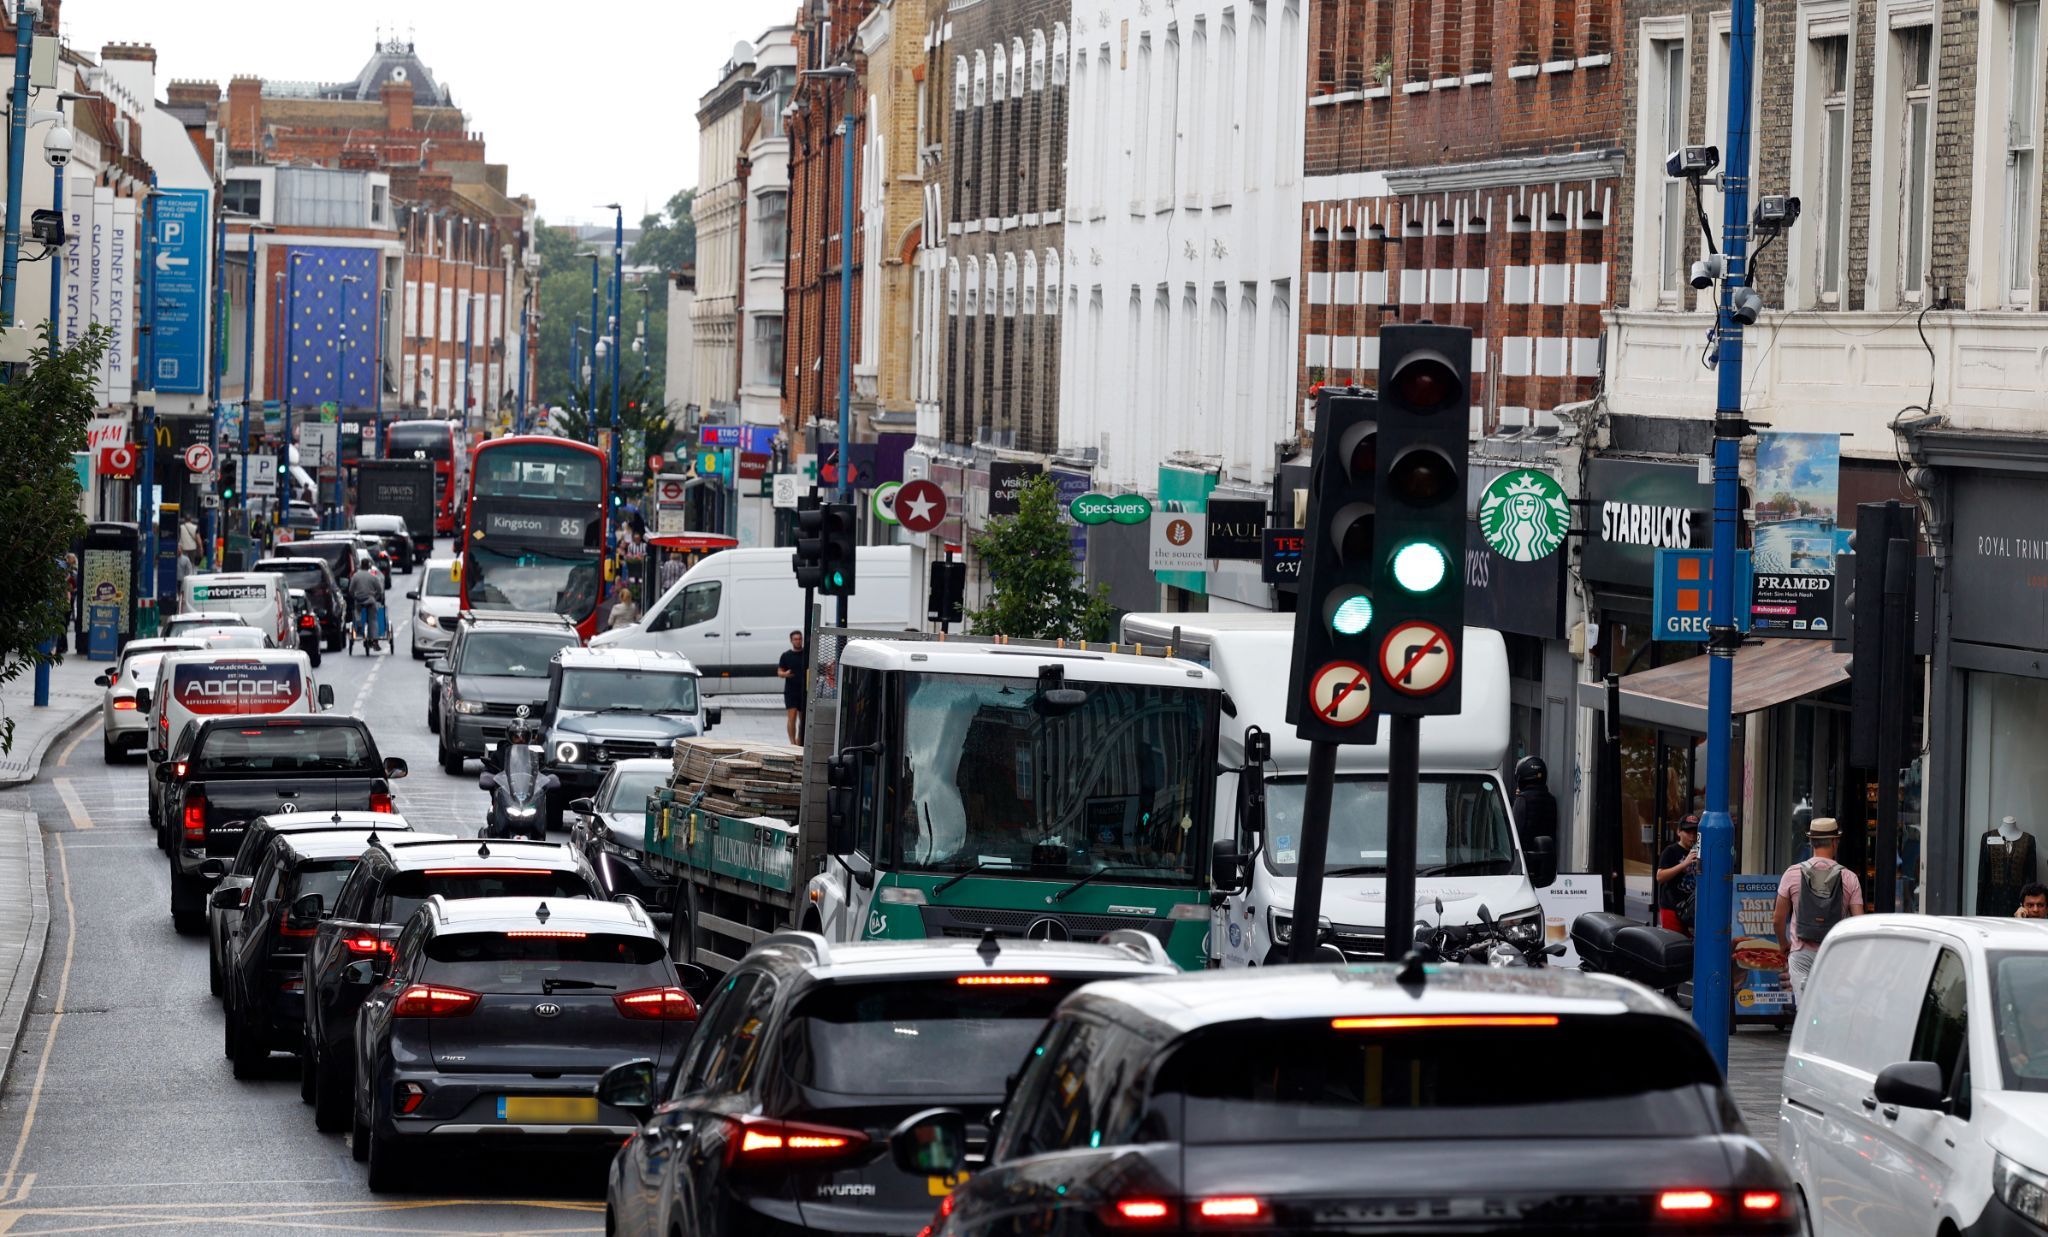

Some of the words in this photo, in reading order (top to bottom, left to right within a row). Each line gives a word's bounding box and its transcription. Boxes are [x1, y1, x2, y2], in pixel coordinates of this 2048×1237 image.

[165, 223, 180, 242] P
[111, 229, 124, 285] PUTNEY
[66, 284, 79, 349] EXCHAN
[109, 291, 123, 372] EXCHANGE
[260, 461, 269, 473] P
[652, 457, 659, 468] L
[1079, 502, 1145, 516] Specsavers
[494, 516, 541, 531] Kingston
[560, 519, 579, 536] 85
[1211, 522, 1262, 537] PAUL
[1602, 500, 1691, 549] STARBUCKS
[1273, 537, 1304, 551] TES
[1978, 535, 2010, 557] ROYAL
[2016, 538, 2048, 560] TRINIT
[1154, 548, 1173, 558] the
[1175, 551, 1203, 559] source
[1757, 577, 1831, 590] FRAMED
[194, 586, 266, 599] enterprise
[1757, 606, 1791, 614] #shopsafely
[1667, 616, 1739, 632] GREGS
[184, 679, 292, 697] ADCOCK
[713, 834, 750, 868] WALLINGTON
[1741, 898, 1776, 911] TASTY
[1738, 911, 1776, 922] SUMME
[539, 1006, 556, 1014] KIA
[817, 1184, 876, 1196] HYUNDAI
